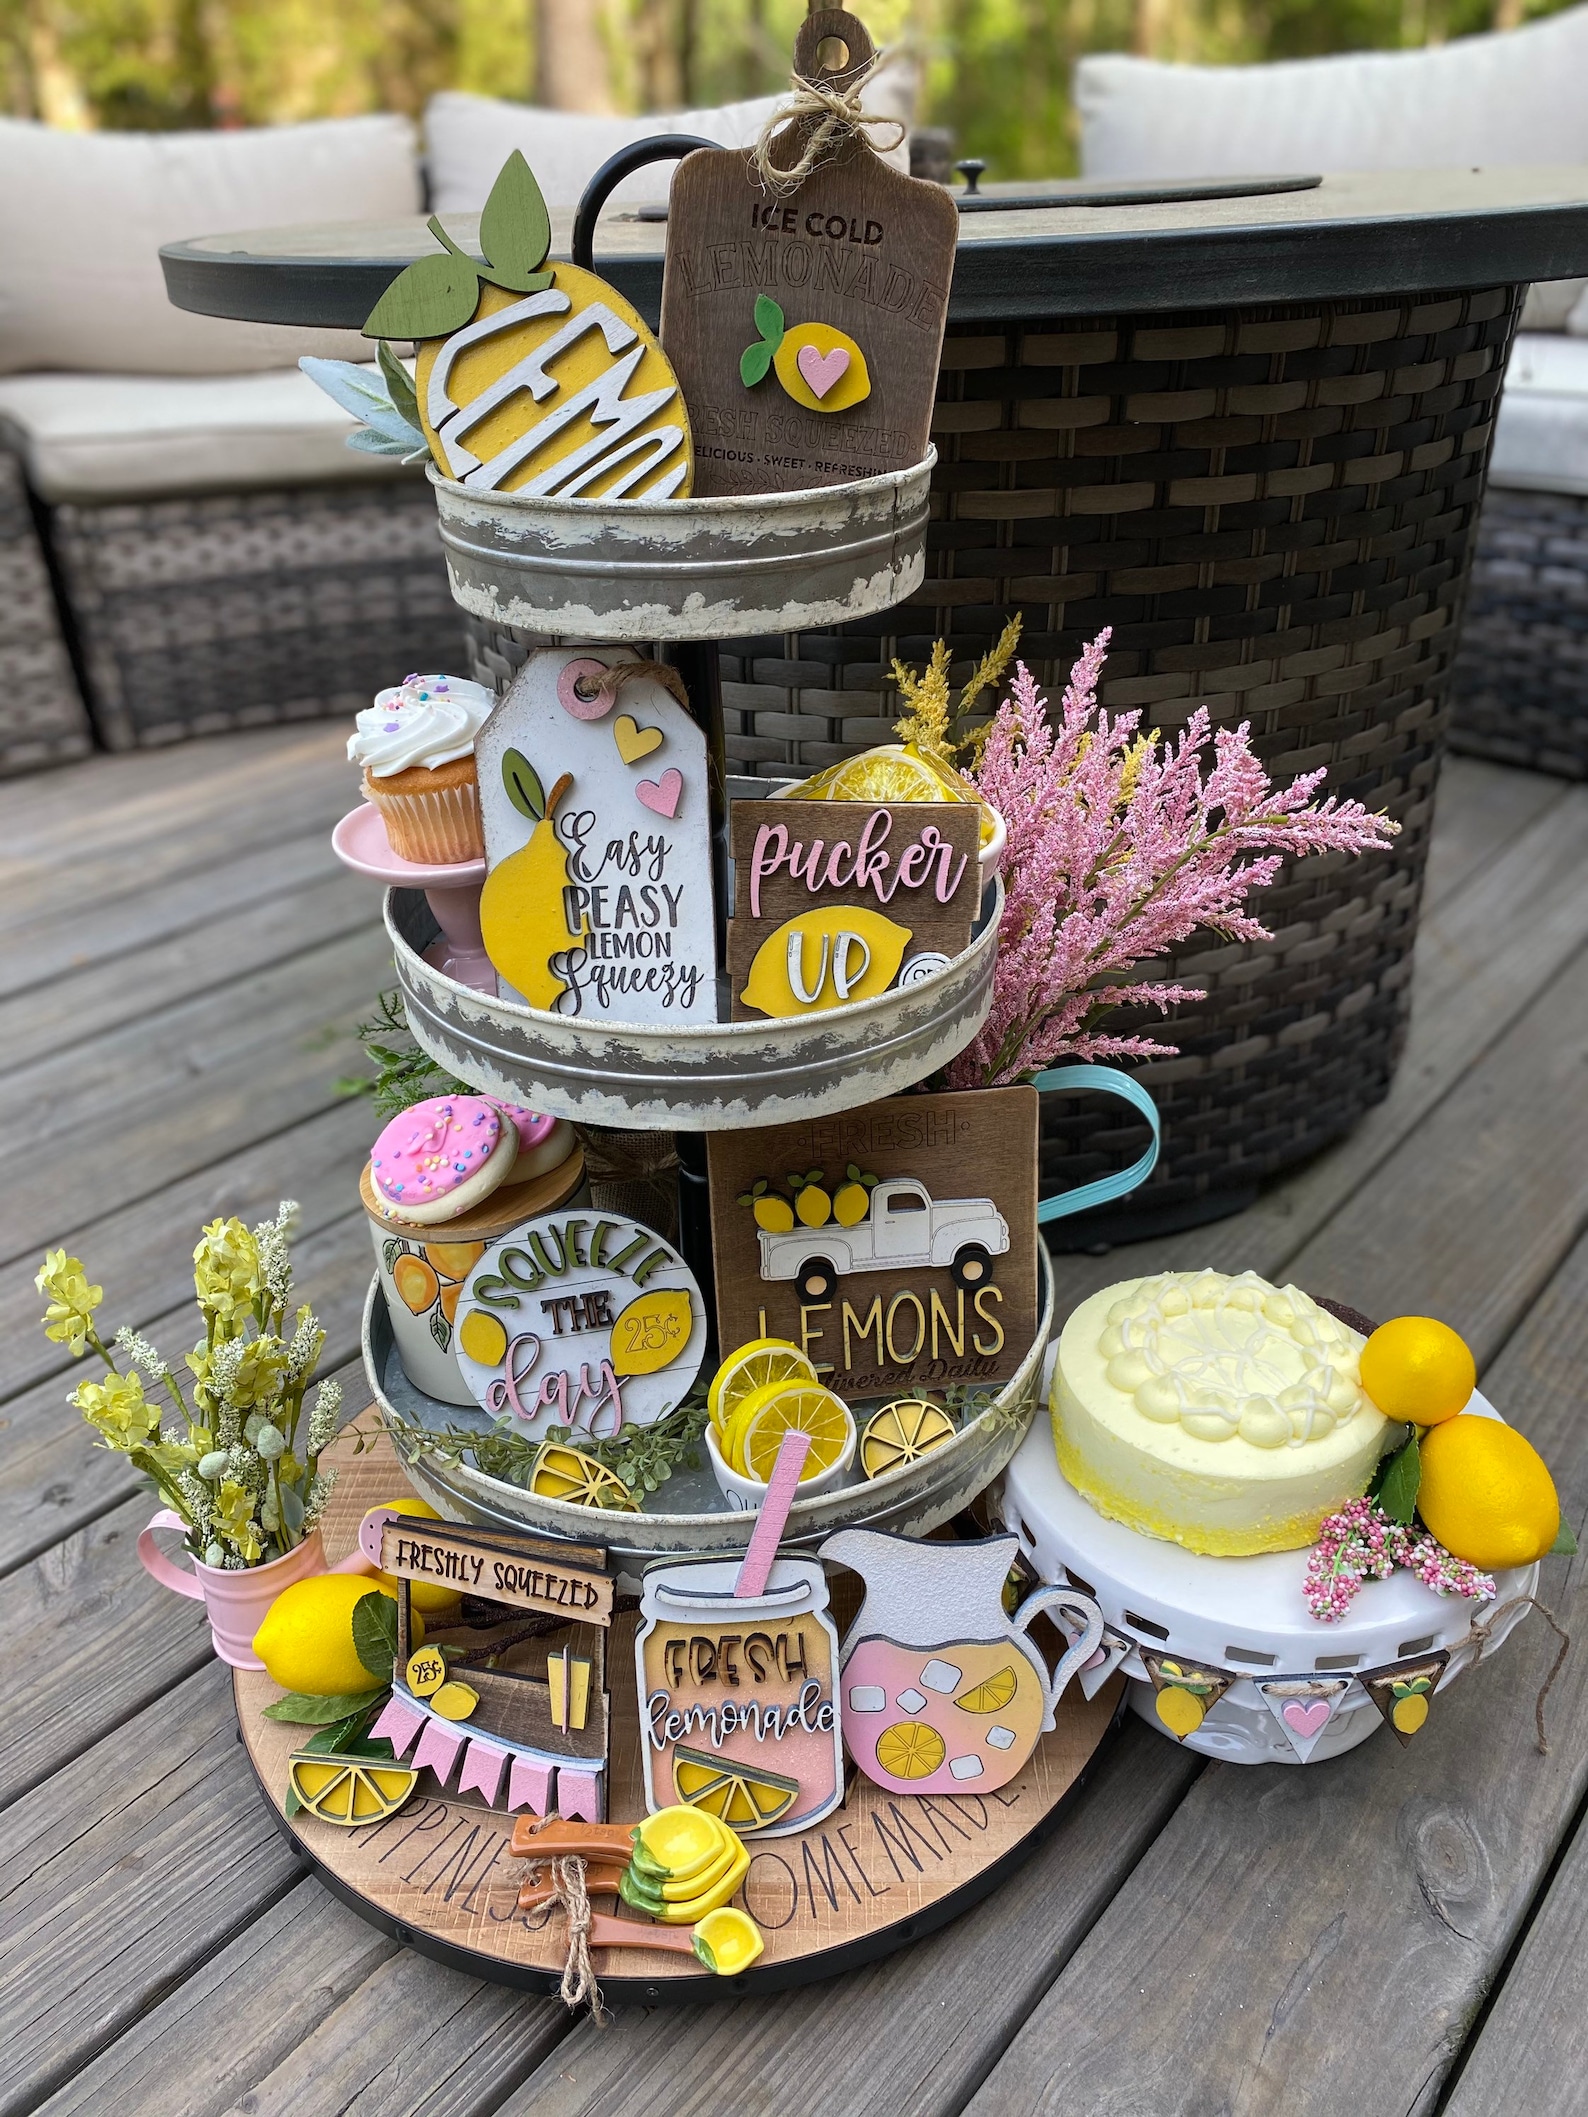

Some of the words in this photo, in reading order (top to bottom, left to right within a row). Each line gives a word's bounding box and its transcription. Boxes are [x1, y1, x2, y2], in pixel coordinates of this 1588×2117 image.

[752, 203, 798, 234] ICE
[805, 212, 884, 245] COLD
[675, 240, 948, 332] LEMONADE
[687, 403, 758, 441] RESH
[695, 445, 754, 464] ELICIOUS
[764, 454, 806, 470] SWEET
[560, 810, 673, 883] Easy
[751, 807, 968, 917] pucker
[567, 884, 684, 931] PEASY
[589, 931, 671, 959] LEMON
[787, 929, 870, 1004] UP
[553, 947, 704, 1017] Squeezy
[473, 1218, 674, 1309] SQUEEZE
[540, 1289, 614, 1335] THE
[624, 1312, 681, 1354] 25¢
[485, 1332, 630, 1437] day
[822, 1361, 916, 1390] livered
[919, 1354, 1001, 1381] Daily
[396, 1538, 484, 1585] FRESHLY
[494, 1561, 599, 1610] SQUEEZED
[412, 1659, 442, 1685] 25¢
[664, 1631, 808, 1688] FRESH
[647, 1678, 834, 1752] lemonade
